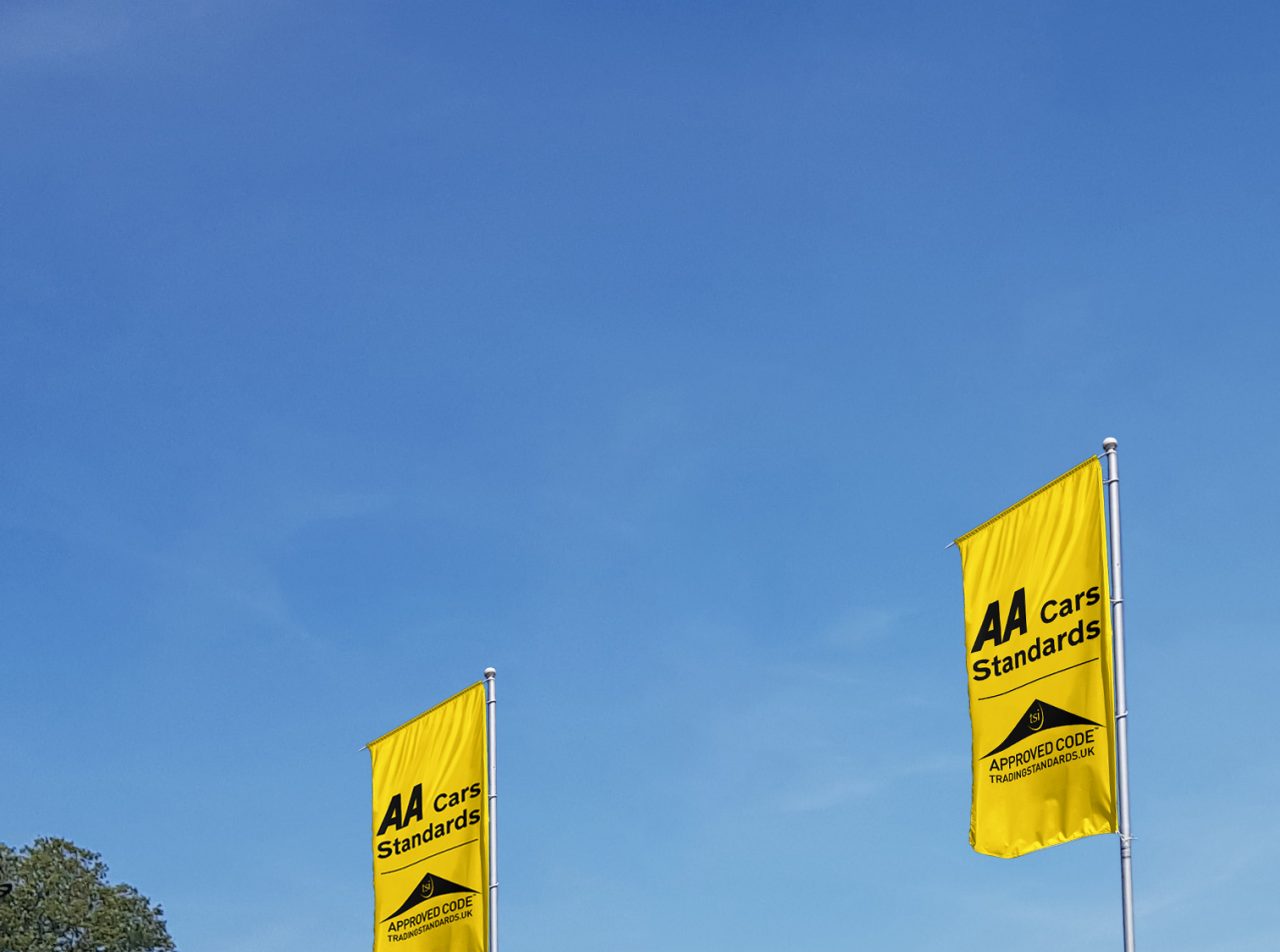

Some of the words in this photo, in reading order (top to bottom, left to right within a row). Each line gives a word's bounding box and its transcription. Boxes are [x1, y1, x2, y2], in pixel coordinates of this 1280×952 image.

[971, 587, 1028, 653] AA
[1040, 586, 1100, 624] Cars
[972, 620, 1101, 681] Standards
[989, 741, 1054, 772] APPROVED
[1055, 729, 1095, 752] CODE
[989, 746, 1095, 784] TRADINGSTANDARDS.UK
[376, 783, 423, 836] AA
[433, 782, 481, 812] Cars
[377, 809, 481, 859] Standards
[388, 906, 441, 932] APPROVED
[442, 895, 473, 914] CODE
[388, 909, 473, 942] TRADINGSTANDARDS.UK
